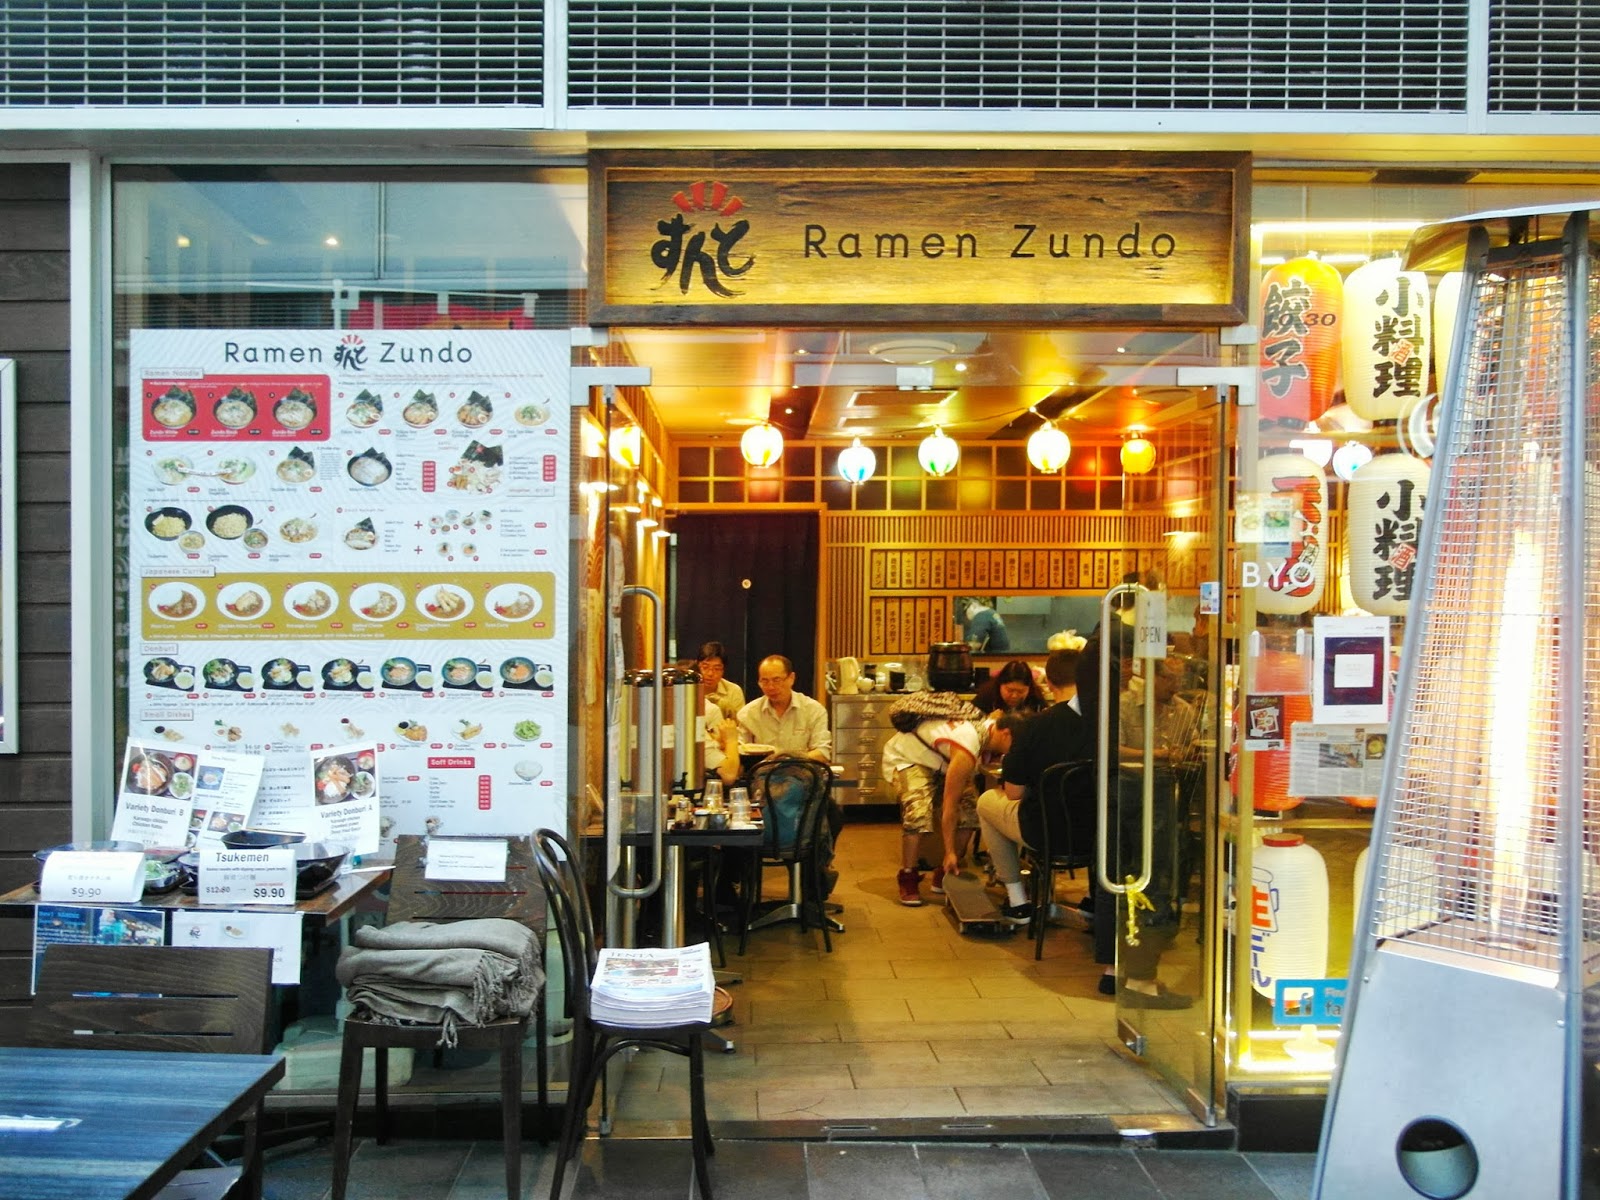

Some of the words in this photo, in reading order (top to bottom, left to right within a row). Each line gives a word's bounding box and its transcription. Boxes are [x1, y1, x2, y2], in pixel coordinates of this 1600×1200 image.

[805, 225, 978, 258] Ramen
[1011, 223, 1176, 259] Zundo
[1372, 277, 1425, 399] 小料理
[225, 342, 322, 363] Ramen
[379, 341, 473, 363] Zundo
[145, 568, 180, 576] Japanese
[1140, 627, 1161, 643] OPEN
[430, 758, 447, 766] Soft
[448, 758, 472, 766] Drinks
[126, 802, 149, 813] Variety
[151, 806, 177, 815] Donburi
[320, 808, 342, 819] Variety
[343, 805, 367, 816] Donburi
[216, 852, 270, 863] Tsukemen
[71, 887, 102, 898] $9.90
[253, 887, 286, 899] $9.90
